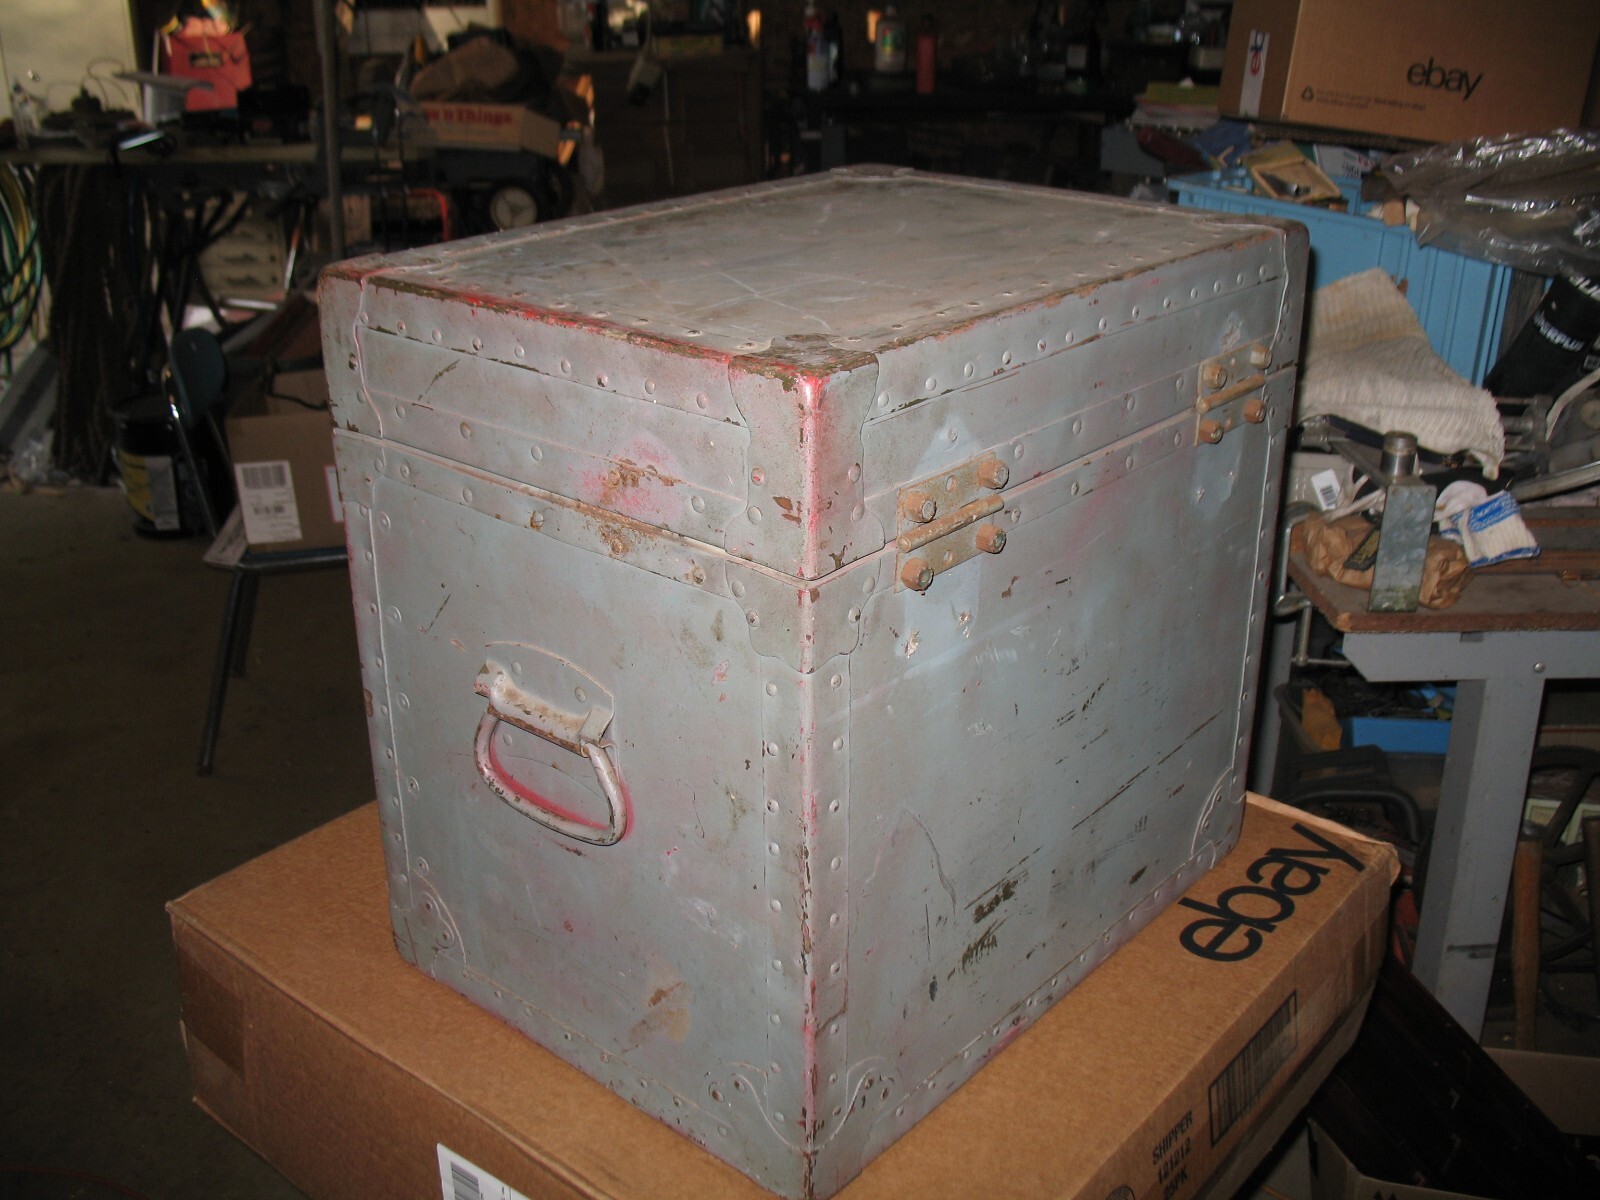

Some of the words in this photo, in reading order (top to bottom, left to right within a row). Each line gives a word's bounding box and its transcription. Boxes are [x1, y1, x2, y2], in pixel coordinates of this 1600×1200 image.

[1407, 57, 1483, 101] ebay
[1178, 823, 1366, 962] ebay
[1152, 1109, 1192, 1165] SHIPPER
